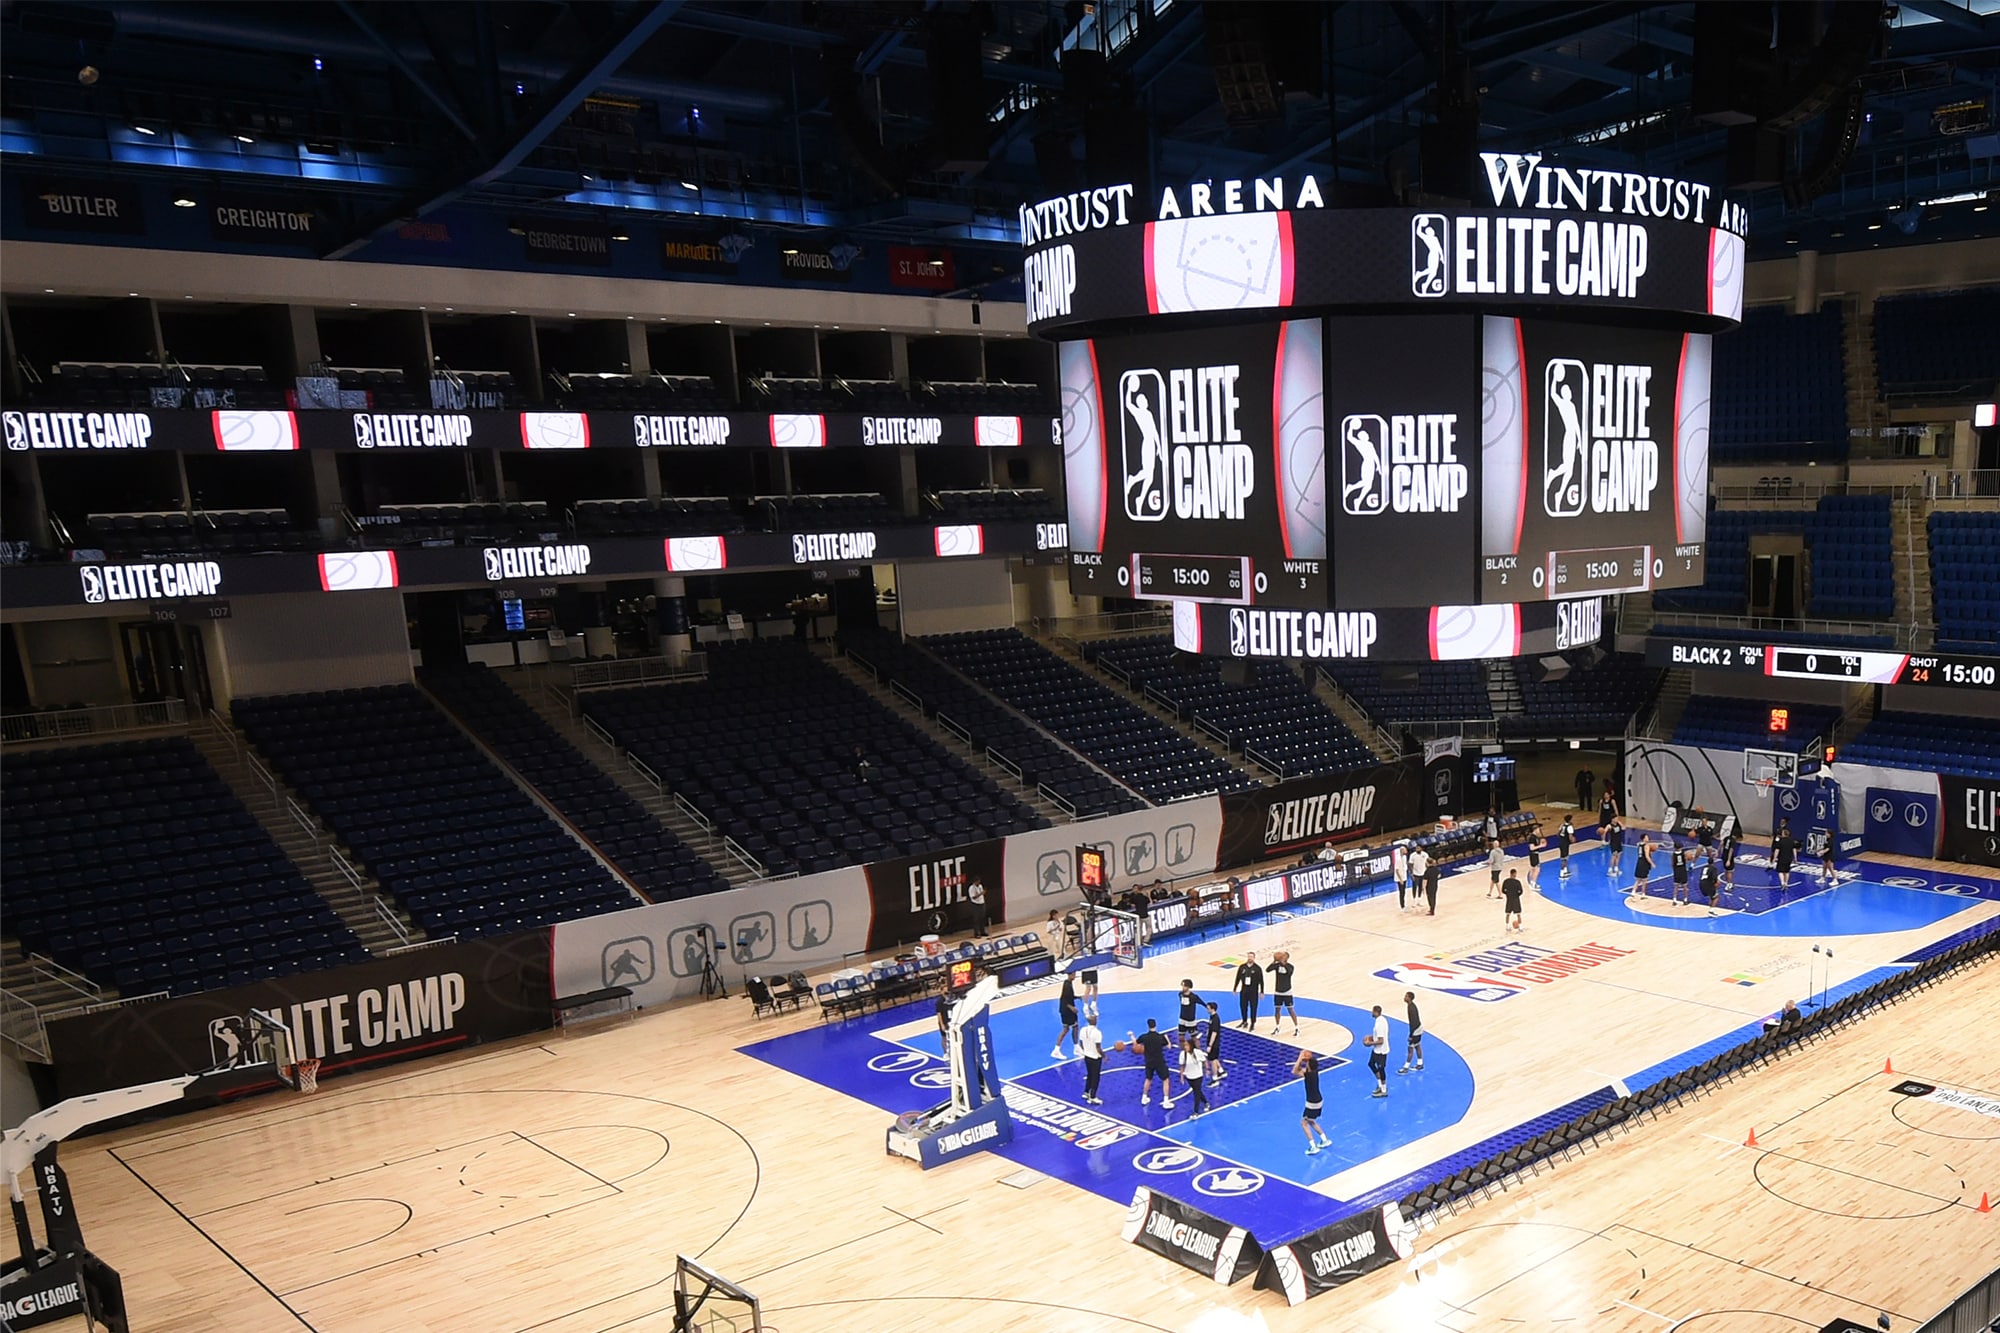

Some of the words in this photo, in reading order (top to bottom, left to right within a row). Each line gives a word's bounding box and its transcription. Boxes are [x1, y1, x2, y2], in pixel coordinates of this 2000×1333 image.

[1479, 152, 1710, 224] WINTRUST
[1719, 199, 1748, 237] ARE
[47, 195, 118, 218] BUTLER
[1019, 183, 1134, 248] INTRUST
[1159, 175, 1324, 219] ARENA
[217, 206, 310, 232] CREIGHTON
[528, 231, 608, 253] GEORGETOWN
[666, 243, 723, 263] MARQUETT
[1456, 216, 1551, 295] ELITE
[1556, 219, 1648, 298] CAMP
[898, 260, 913, 276] ST.
[1034, 244, 1076, 321] CAMP
[1170, 365, 1242, 443] ELITE
[1592, 364, 1651, 438] ELITE
[27, 412, 90, 448] ELITE
[90, 412, 152, 448] CAMP
[373, 414, 421, 447] ELITE
[421, 414, 473, 447] CAMP
[649, 415, 689, 446] ELITE
[689, 415, 731, 446] CAMP
[875, 417, 908, 444] ELITE
[908, 417, 942, 444] CAMP
[1391, 414, 1457, 463] ELITE
[1173, 444, 1254, 519] CAMP
[1591, 440, 1658, 512] CAMP
[1392, 464, 1468, 512] CAMP
[806, 533, 841, 561] ELITE
[841, 532, 876, 559] CAMP
[1047, 524, 1068, 548] ELIT
[502, 546, 545, 578] ELITE
[546, 545, 591, 576] CAMP
[1073, 554, 1103, 566] BLACK
[1675, 545, 1700, 557] WHITE
[847, 568, 859, 576] 110
[1088, 568, 1094, 579] 2
[1283, 562, 1319, 574] WHITE
[1486, 557, 1517, 570] BLACK
[1586, 561, 1618, 579] 15:00
[1633, 568, 1643, 577] 00
[1653, 558, 1663, 579] 0
[1685, 559, 1691, 570] 3
[104, 565, 160, 600] ELITE
[161, 562, 222, 597] CAMP
[813, 570, 827, 579] 109
[1117, 566, 1129, 586] 0
[1142, 576, 1153, 585] 00
[1172, 568, 1210, 585] 15:00
[1229, 579, 1241, 588] 00
[1255, 572, 1268, 593] 0
[1300, 578, 1307, 589] 3
[1501, 573, 1508, 584] 2
[1532, 567, 1544, 588] 0
[1557, 575, 1567, 584] 00
[498, 590, 515, 598] 108
[539, 587, 556, 596] 109
[155, 610, 176, 620] 106
[208, 607, 228, 617] 107
[1571, 599, 1595, 646] ELITE
[1249, 610, 1302, 657] ELITE
[1305, 611, 1377, 658] CAMP
[1672, 645, 1718, 663] BLACK
[1722, 648, 1731, 665] 2
[1740, 647, 1763, 656] FOUL
[1745, 657, 1755, 665] 00
[1840, 656, 1859, 666] TOL
[1806, 655, 1816, 671] 0
[1846, 667, 1851, 675] 0
[1909, 657, 1938, 668] SHOT
[1912, 669, 1929, 682] 24
[1942, 664, 1995, 684] 15:00
[1770, 718, 1787, 730] 24
[1281, 793, 1327, 840] ELITE
[1326, 786, 1375, 830] CAMP
[1966, 788, 2000, 832] ELI
[909, 855, 968, 913] ELITE
[1302, 867, 1323, 896] ELITE
[1157, 903, 1187, 931] CAMP
[1450, 941, 1556, 973] DRAFT
[1501, 942, 1637, 984] COMBINE
[358, 972, 465, 1047] CAMP
[978, 1026, 989, 1052] NBA
[981, 1053, 990, 1071] TV
[1935, 1092, 1959, 1102] PRO
[44, 1165, 59, 1195] NBA
[51, 1197, 63, 1216] TV
[1156, 1214, 1173, 1244] NBA
[1171, 1224, 1184, 1248] G
[1184, 1227, 1219, 1261] LEAGUE
[1323, 1243, 1349, 1273] ELITE
[1348, 1231, 1376, 1261] CAMP
[15, 1294, 35, 1316] G
[34, 1283, 79, 1311] LEAGUE
